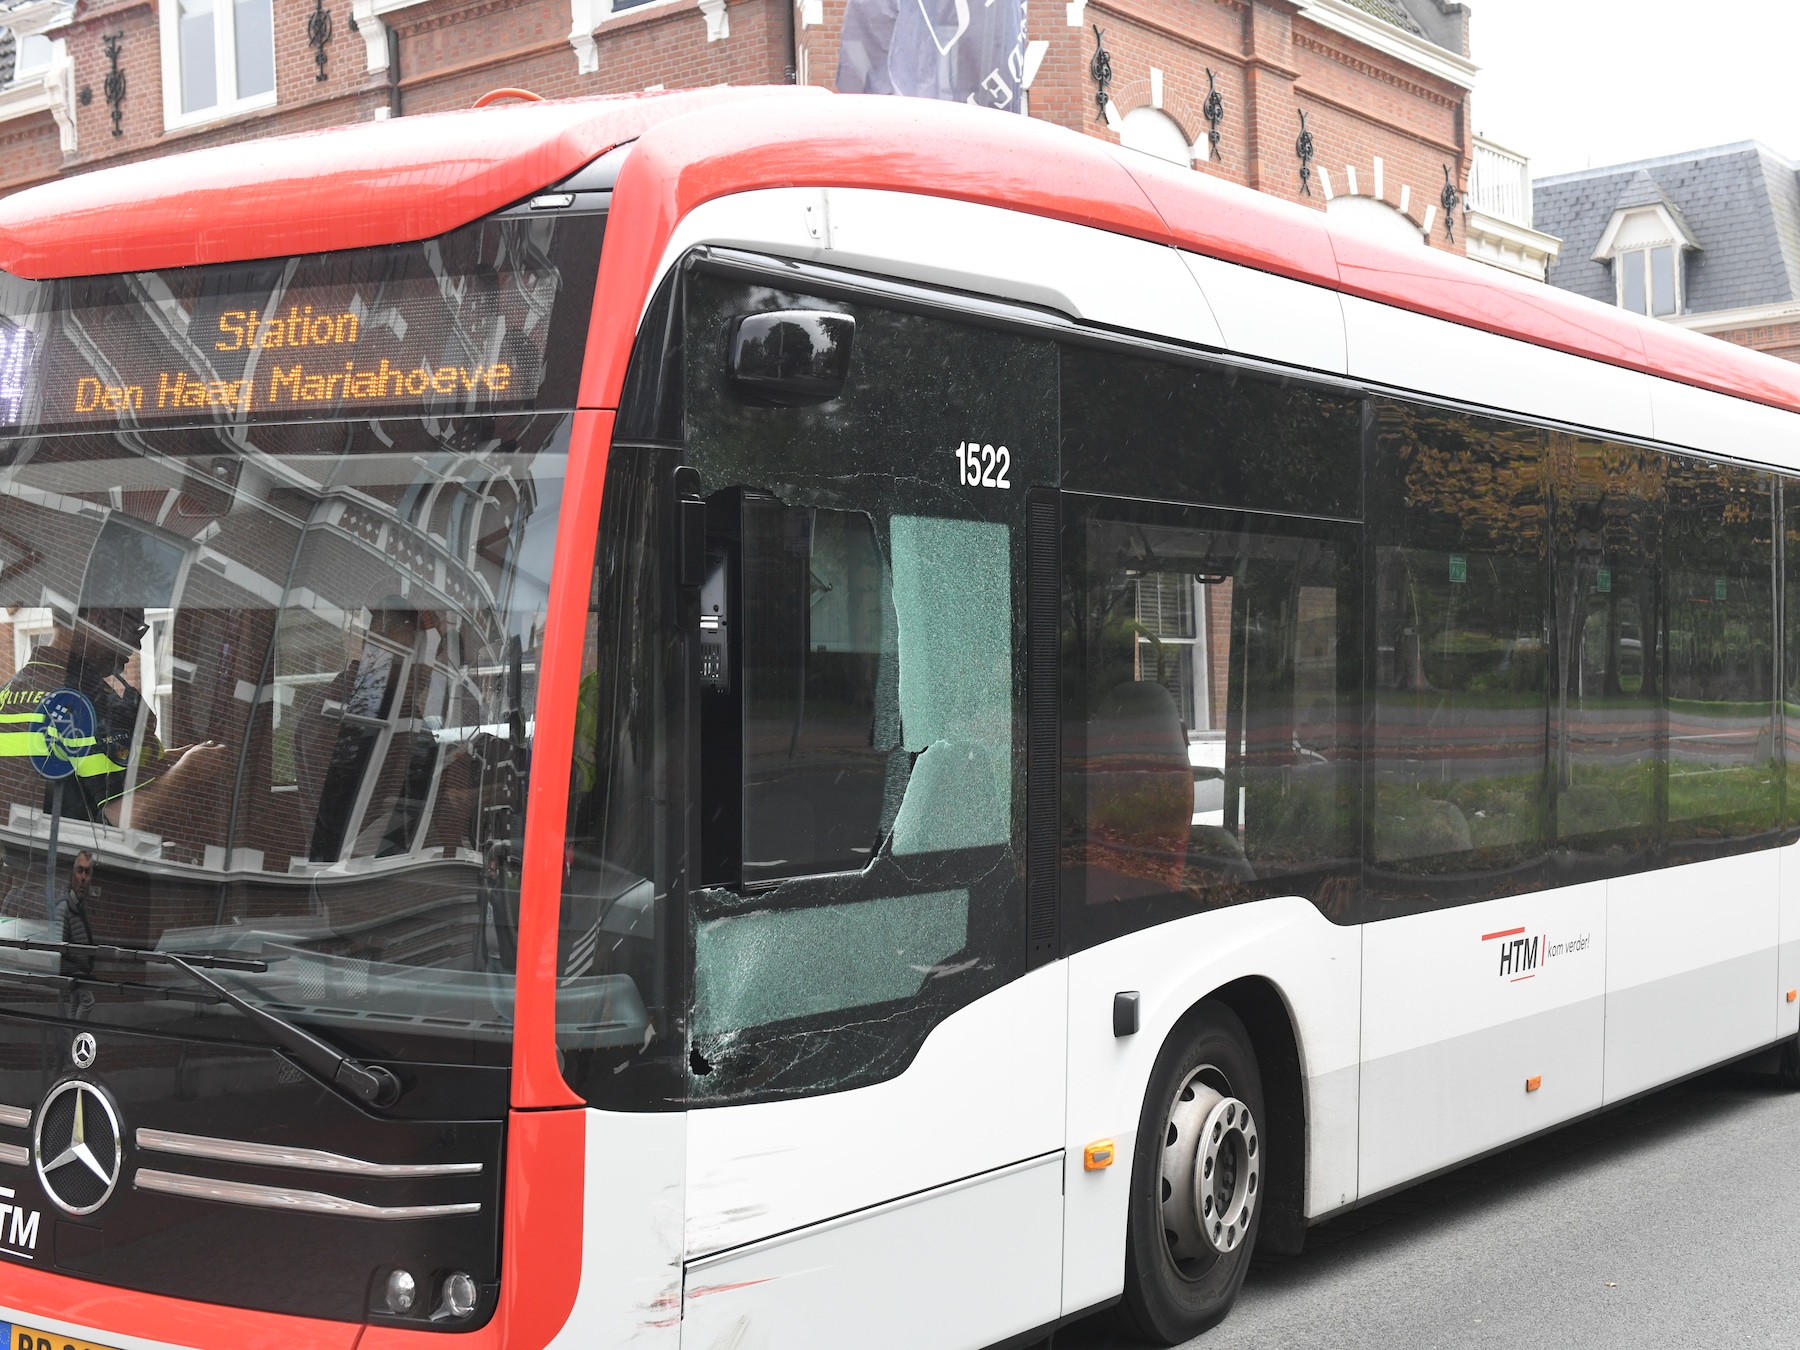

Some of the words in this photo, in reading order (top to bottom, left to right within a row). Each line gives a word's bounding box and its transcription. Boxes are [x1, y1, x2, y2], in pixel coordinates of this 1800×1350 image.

[215, 307, 360, 351] Station
[75, 376, 143, 412] Den
[157, 371, 254, 412] Haag
[268, 359, 512, 402] Mariahoeve
[955, 440, 1011, 490] 1522
[1499, 935, 1539, 977] HTM
[1547, 940, 1564, 958] kom
[1565, 932, 1591, 953] verder!
